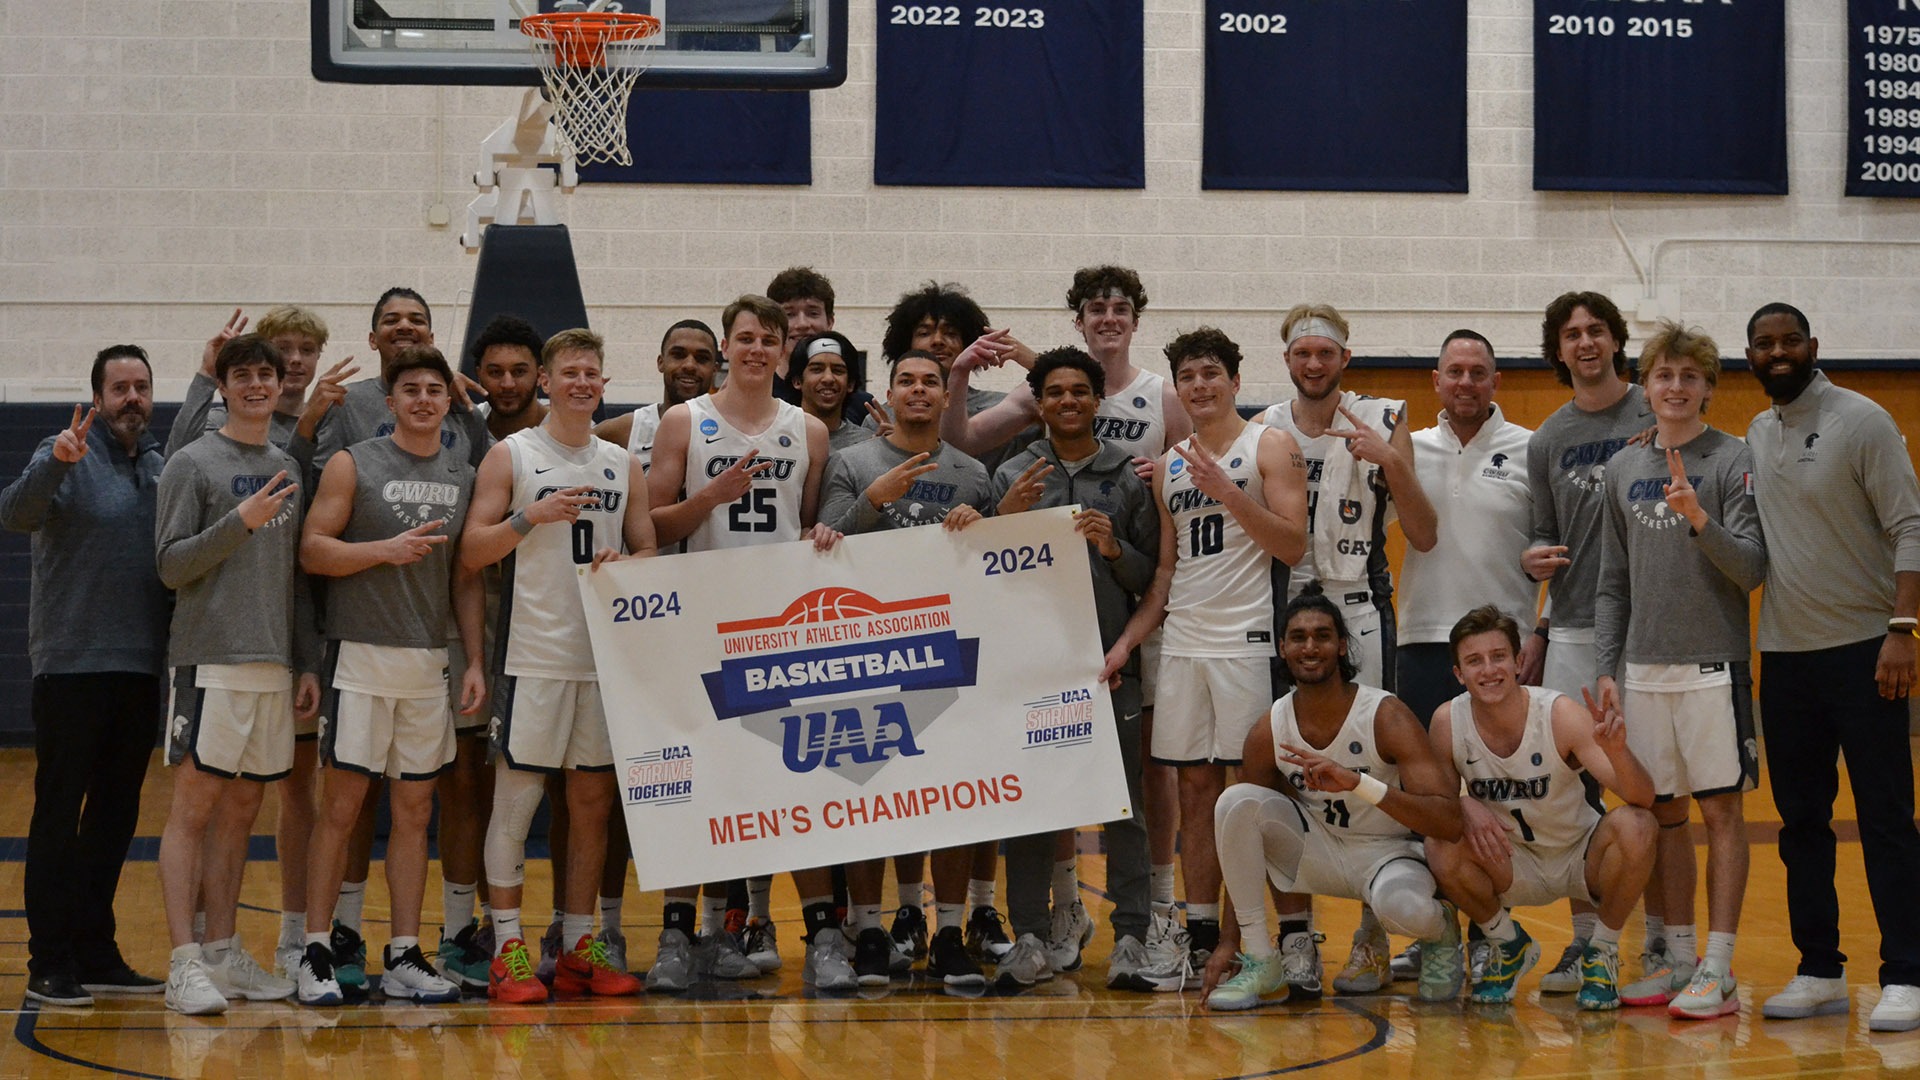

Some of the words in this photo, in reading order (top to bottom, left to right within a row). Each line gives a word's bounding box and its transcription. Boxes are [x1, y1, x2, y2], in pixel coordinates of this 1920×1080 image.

[890, 5, 961, 25] 2022
[975, 7, 1045, 28] 2023
[1219, 13, 1287, 33] 2002
[1549, 15, 1615, 36] 2010
[1627, 17, 1693, 38] 2015
[1863, 25, 1920, 46] 1975
[1864, 52, 1920, 73] 1980
[1864, 79, 1920, 100] 1984
[1864, 107, 1920, 128] 1989
[1863, 135, 1920, 155] 1994
[1861, 161, 1920, 182] 2000
[383, 480, 460, 506] CWRU
[729, 488, 777, 532] 25
[572, 520, 593, 564] 0
[1190, 513, 1224, 557] 10
[983, 543, 1054, 576] 2024
[612, 591, 681, 622] 2024
[724, 630, 798, 655] UNIVERSITY
[806, 623, 862, 645] ATHLETIC
[868, 610, 951, 637] ASSOCIATION
[745, 645, 945, 692] BASKETBALL
[1061, 688, 1092, 704] UAA
[1026, 701, 1093, 730] STRIVE
[779, 701, 925, 773] UAA
[1026, 722, 1093, 744] TOGETHER
[662, 745, 692, 760] UAA
[627, 759, 693, 786] STRIVE
[628, 780, 692, 801] TOGETHER
[1469, 773, 1551, 802] CWRU
[709, 805, 812, 845] MEN'S
[822, 774, 1023, 829] CHAMPIONS
[1323, 799, 1350, 829] 11
[1510, 808, 1535, 842] 1
